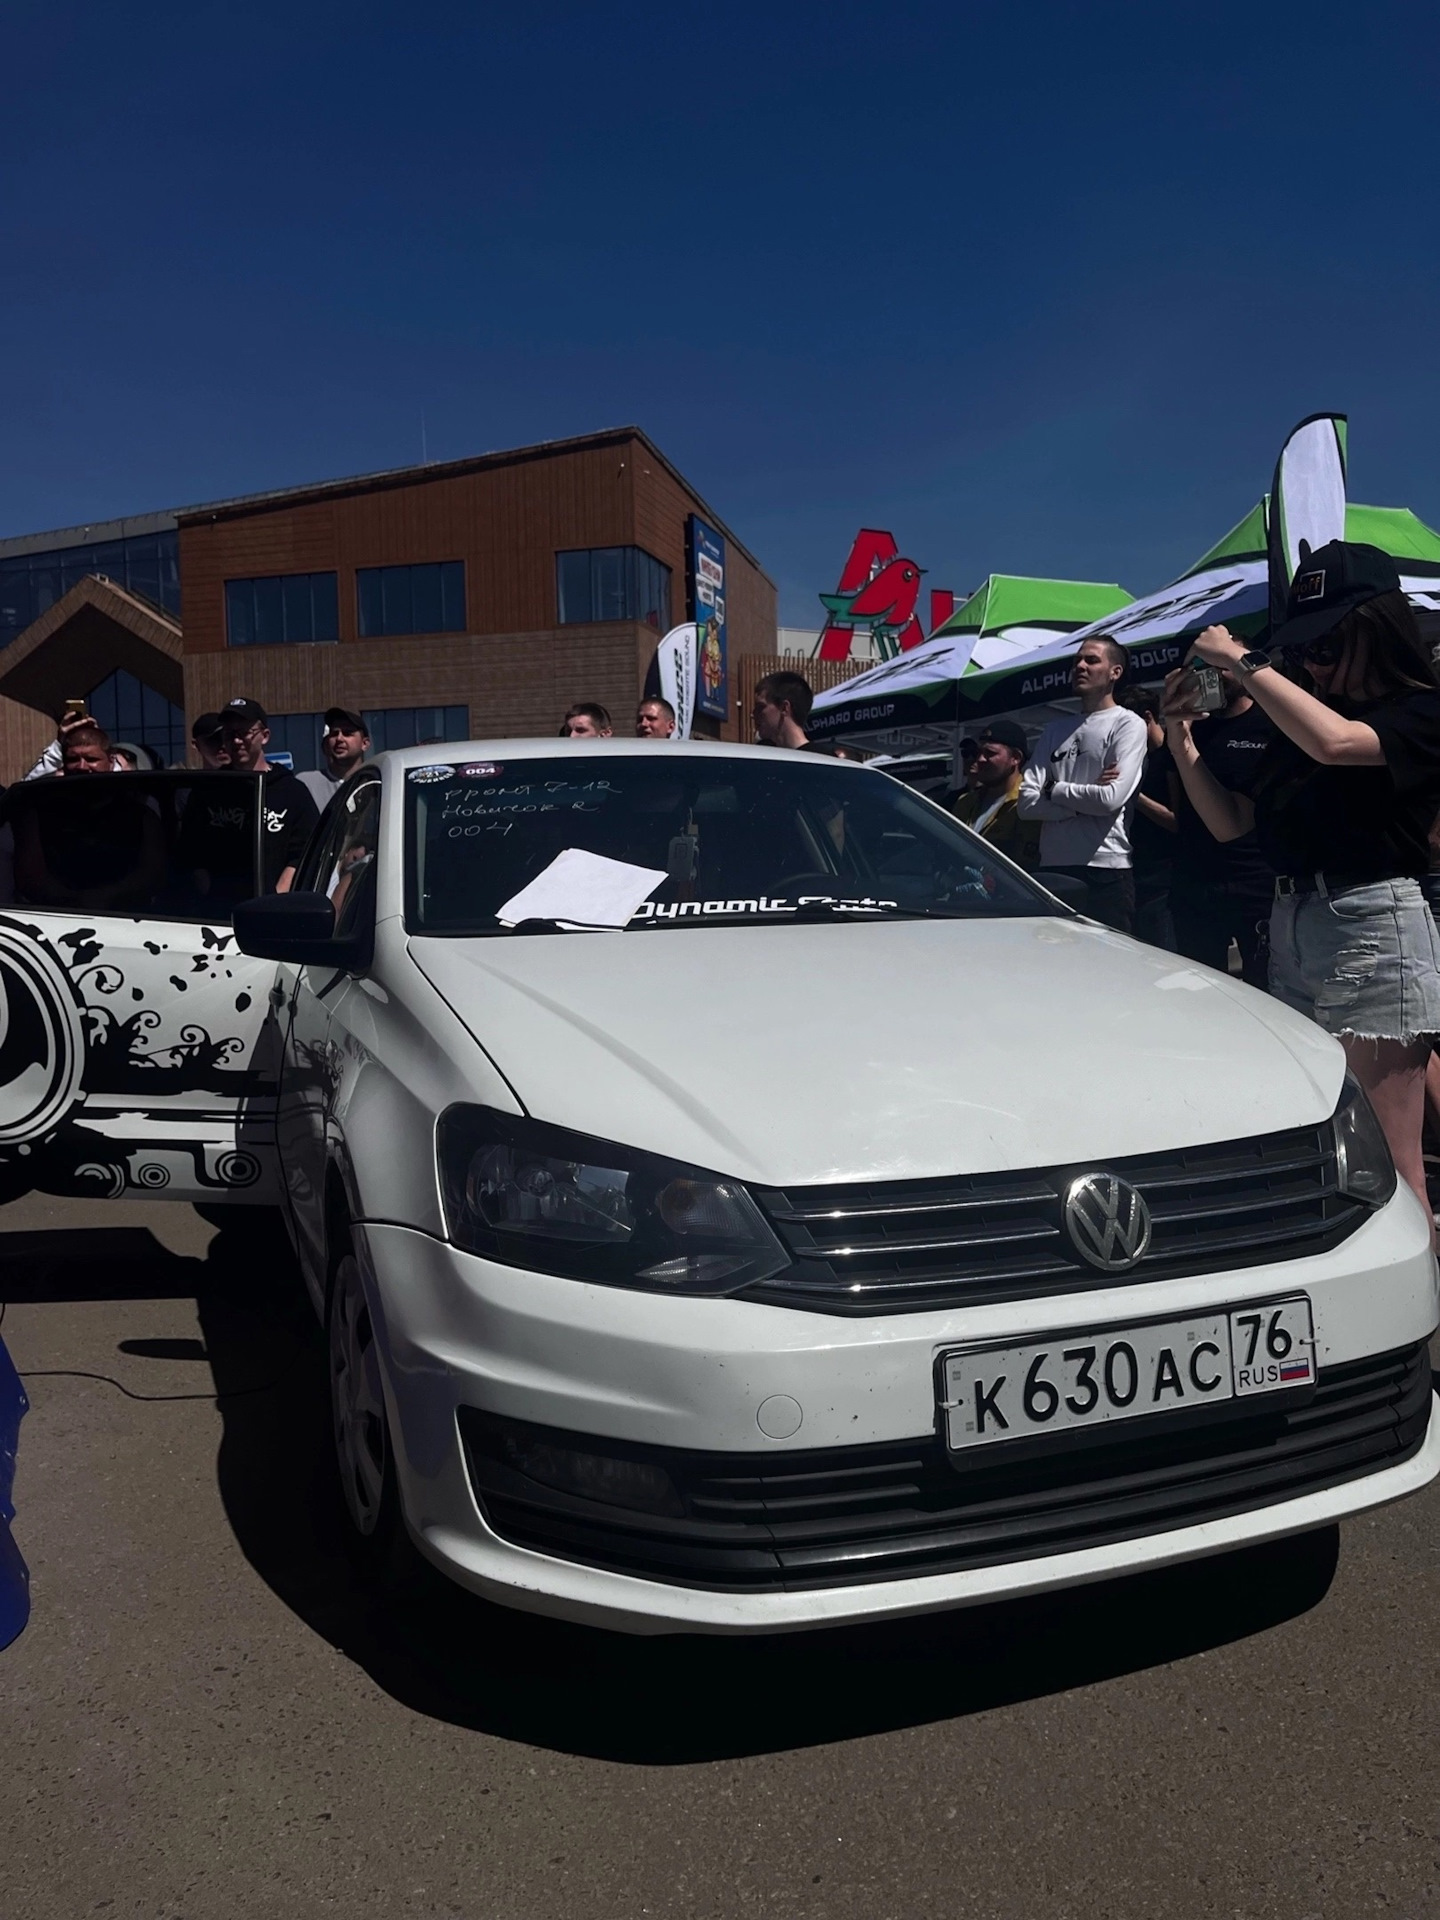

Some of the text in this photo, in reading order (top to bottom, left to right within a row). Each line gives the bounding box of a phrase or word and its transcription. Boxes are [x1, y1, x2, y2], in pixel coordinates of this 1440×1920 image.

[854, 703, 895, 721] GROUP
[465, 767, 496, 775] 004
[447, 820, 514, 838] 004
[632, 896, 798, 919] Dynamic
[1237, 1309, 1293, 1366] 76
[1239, 1364, 1279, 1388] RUS
